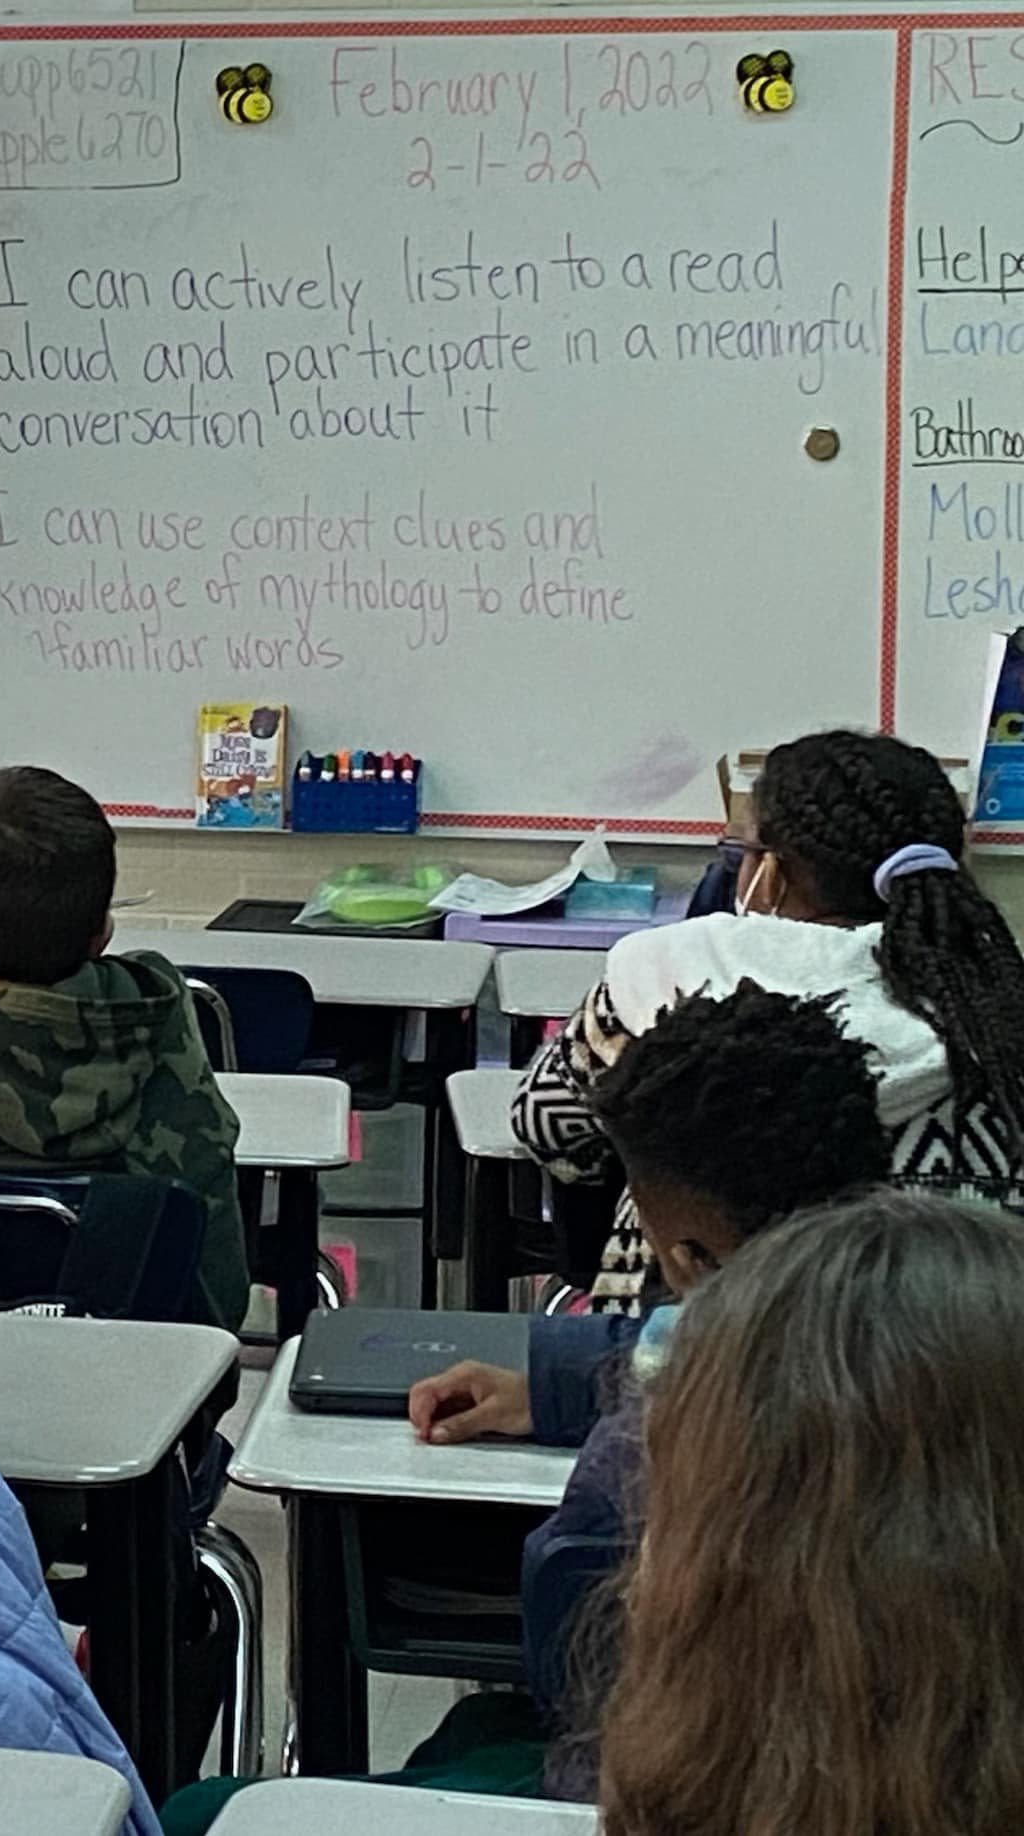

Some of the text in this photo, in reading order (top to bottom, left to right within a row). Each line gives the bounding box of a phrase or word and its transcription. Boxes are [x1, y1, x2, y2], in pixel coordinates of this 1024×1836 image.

[330, 46, 536, 150] February
[598, 41, 713, 117] 2022
[67, 268, 150, 310] can
[172, 241, 363, 336] actively
[403, 230, 539, 304] listen
[550, 231, 605, 291] to
[622, 253, 653, 290] a
[670, 219, 783, 294] read
[143, 320, 234, 383] and
[266, 307, 539, 417] participate
[566, 312, 599, 365] in
[625, 323, 657, 362] a
[677, 282, 882, 396] meaningful
[289, 385, 425, 441] about
[463, 382, 501, 442] it
[43, 506, 123, 550] can
[138, 510, 208, 552] use
[230, 489, 376, 552] context
[393, 488, 507, 553] clues
[523, 480, 605, 559] and
[205, 551, 242, 611] of
[259, 558, 449, 651] mythology
[458, 562, 503, 615] to
[519, 556, 635, 624] define
[227, 617, 346, 672] words
